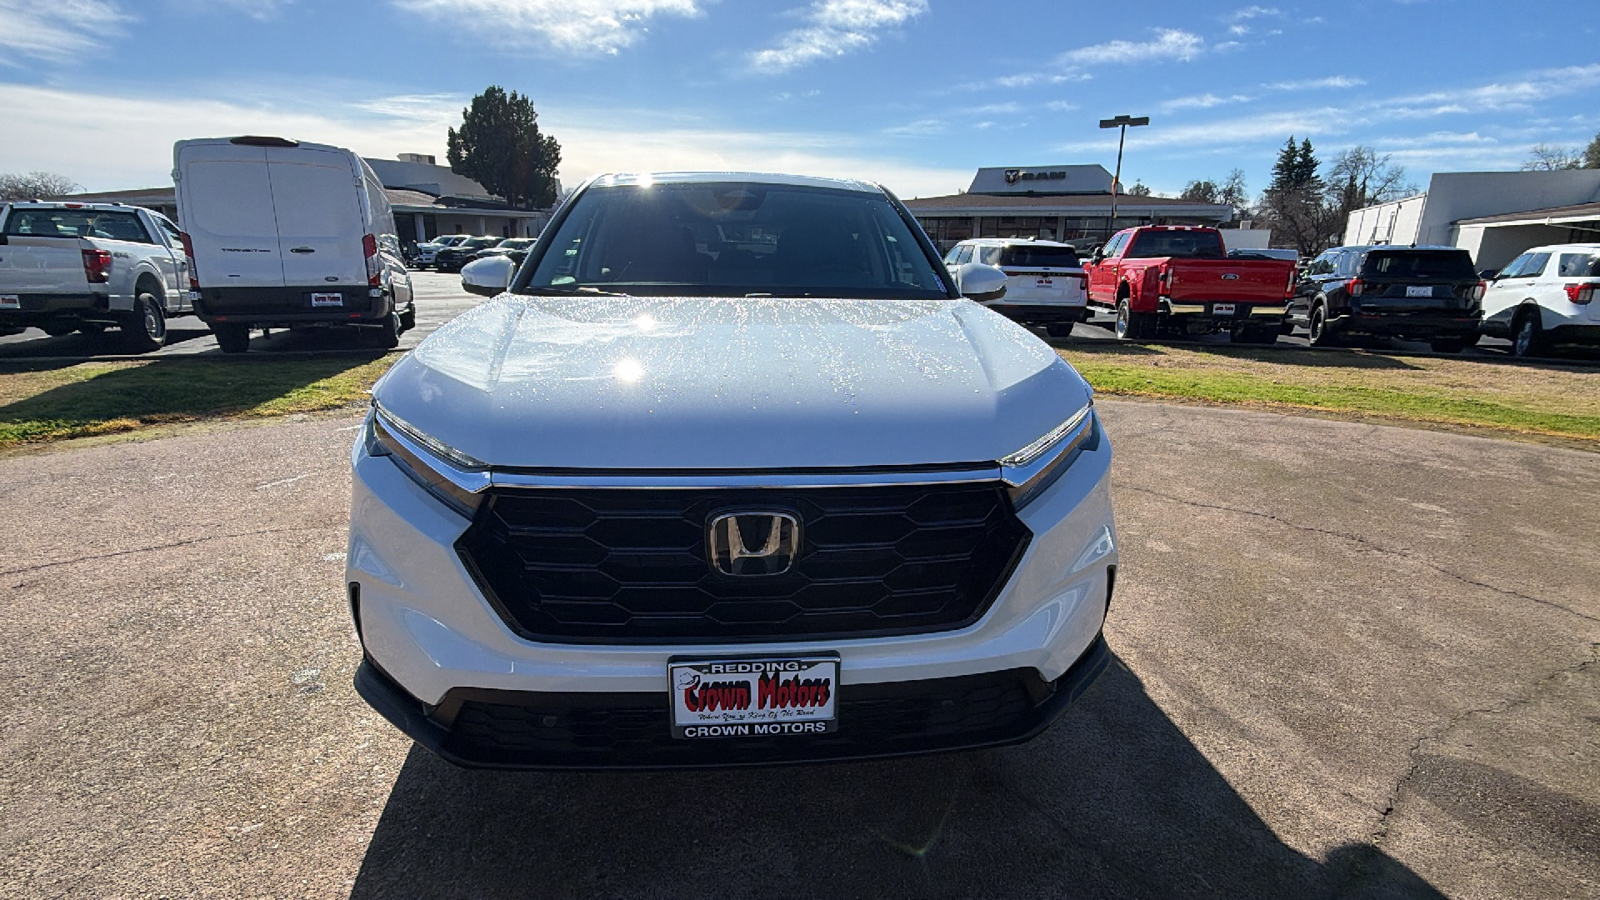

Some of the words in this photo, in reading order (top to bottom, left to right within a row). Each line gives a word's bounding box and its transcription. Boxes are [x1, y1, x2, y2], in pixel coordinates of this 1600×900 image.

[711, 662, 799, 674] REDDING
[684, 680, 751, 712] Crown
[758, 672, 830, 710] Motors
[698, 712, 721, 720] Where
[748, 711, 766, 720] King
[768, 711, 778, 719] Of
[780, 709, 793, 717] The
[796, 708, 815, 716] Road
[684, 725, 750, 738] CROWN
[754, 722, 826, 735] MOTORS
